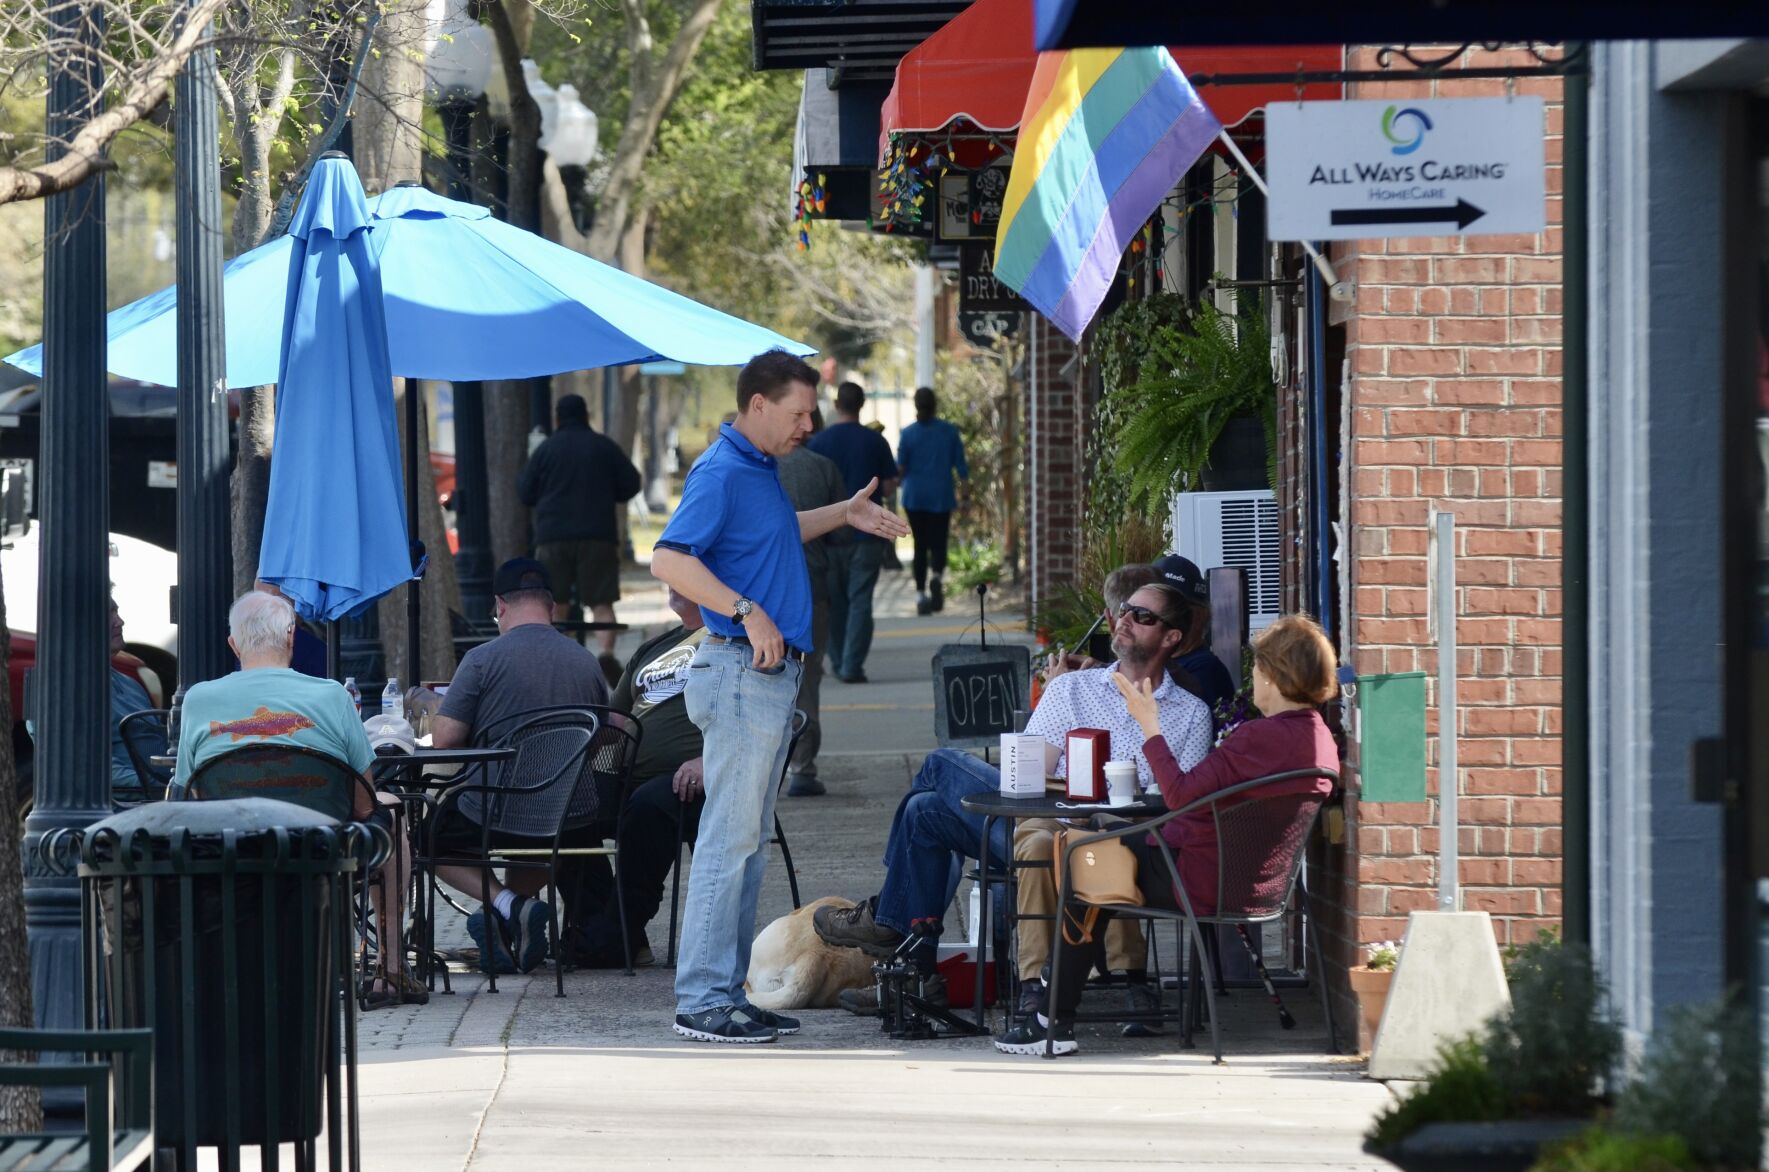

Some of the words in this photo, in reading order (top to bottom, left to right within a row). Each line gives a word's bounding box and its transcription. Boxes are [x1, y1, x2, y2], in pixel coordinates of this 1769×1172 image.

[1420, 160, 1505, 182] CARING
[967, 275, 1000, 300] DRY
[949, 670, 1018, 727] OPEN
